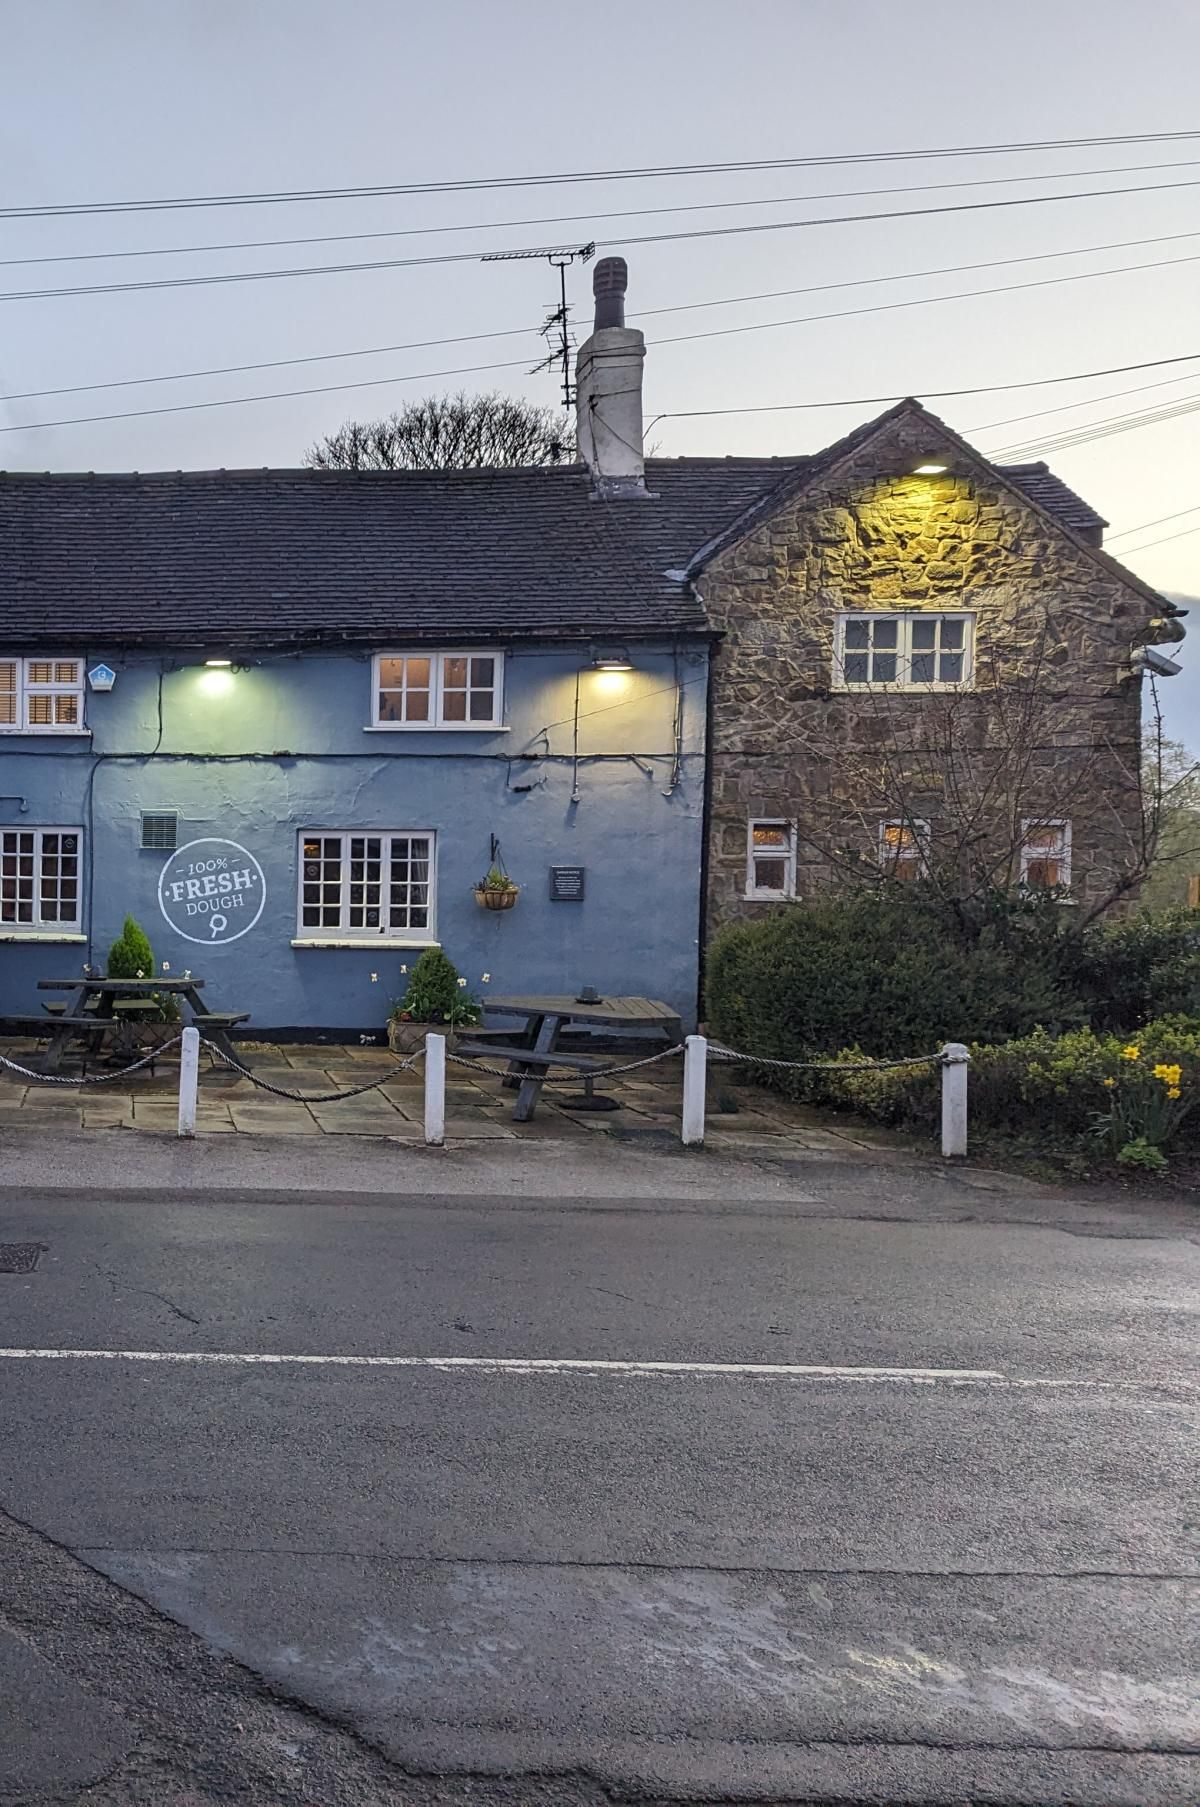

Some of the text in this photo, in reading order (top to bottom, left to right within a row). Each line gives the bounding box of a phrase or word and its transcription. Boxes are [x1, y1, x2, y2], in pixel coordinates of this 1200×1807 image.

[188, 858, 228, 875] 100%
[169, 868, 253, 902] FRESH
[186, 894, 244, 915] DOUGH
